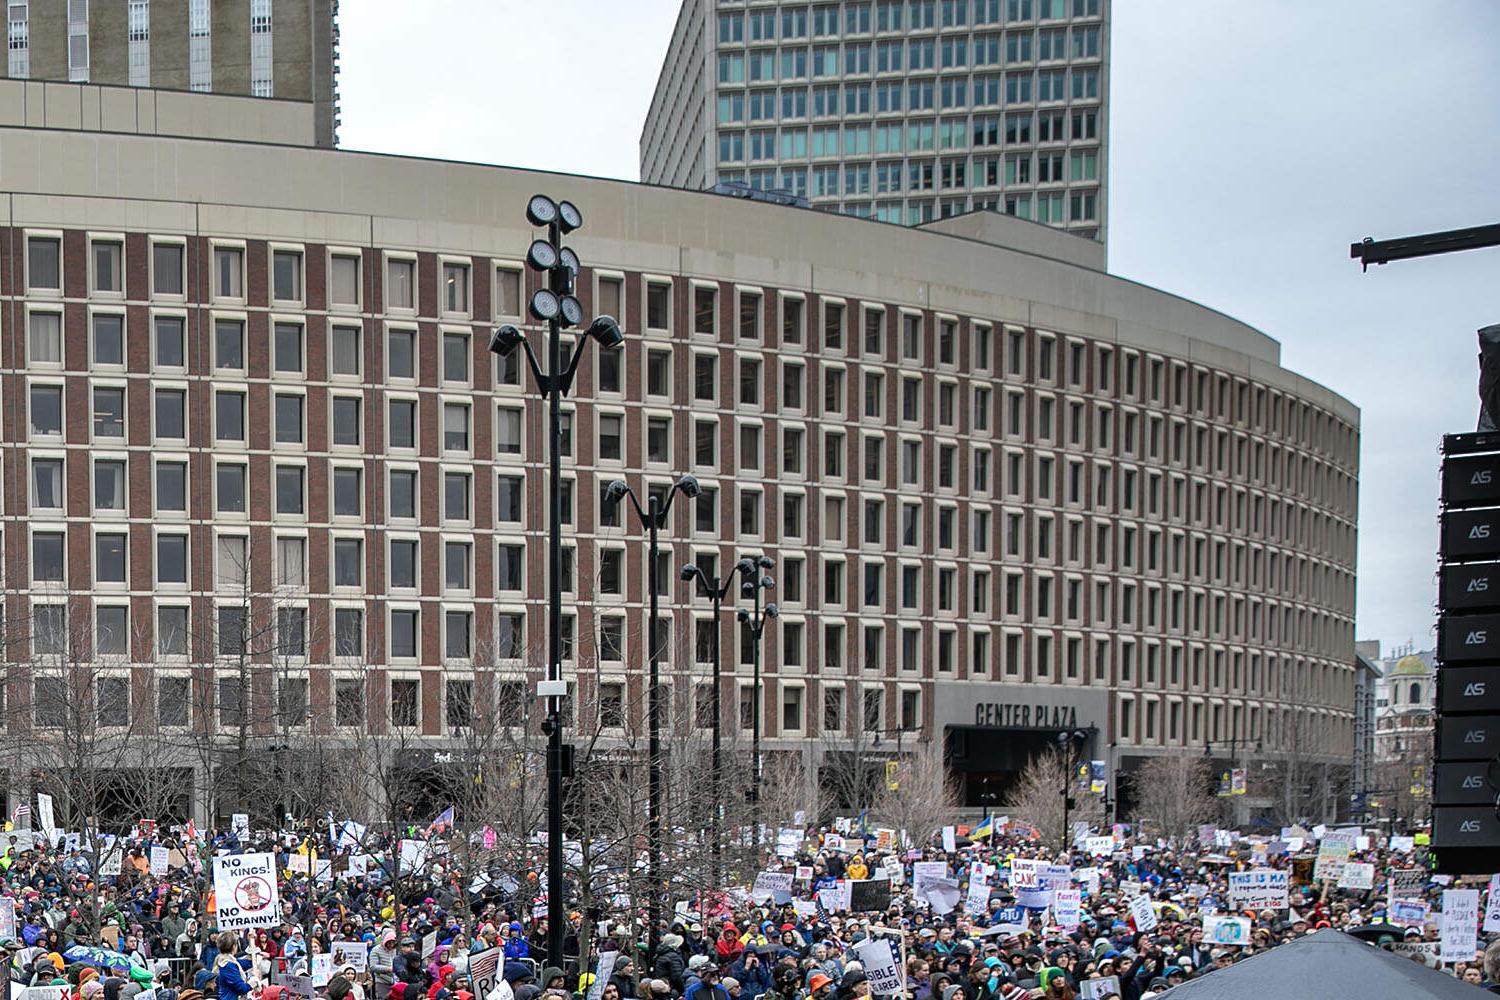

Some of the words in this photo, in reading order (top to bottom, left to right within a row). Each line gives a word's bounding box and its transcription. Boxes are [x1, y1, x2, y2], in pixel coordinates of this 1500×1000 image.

[976, 703, 1030, 726] CENTER
[1035, 705, 1077, 728] PLAZA
[222, 858, 241, 868] NO
[231, 857, 270, 876] KINGS!
[1231, 875, 1250, 883] THIS
[1256, 874, 1264, 882] IS
[1270, 874, 1286, 882] MA
[220, 907, 239, 917] NO
[220, 904, 278, 927] TYRANNY!
[879, 979, 901, 991] AREA
